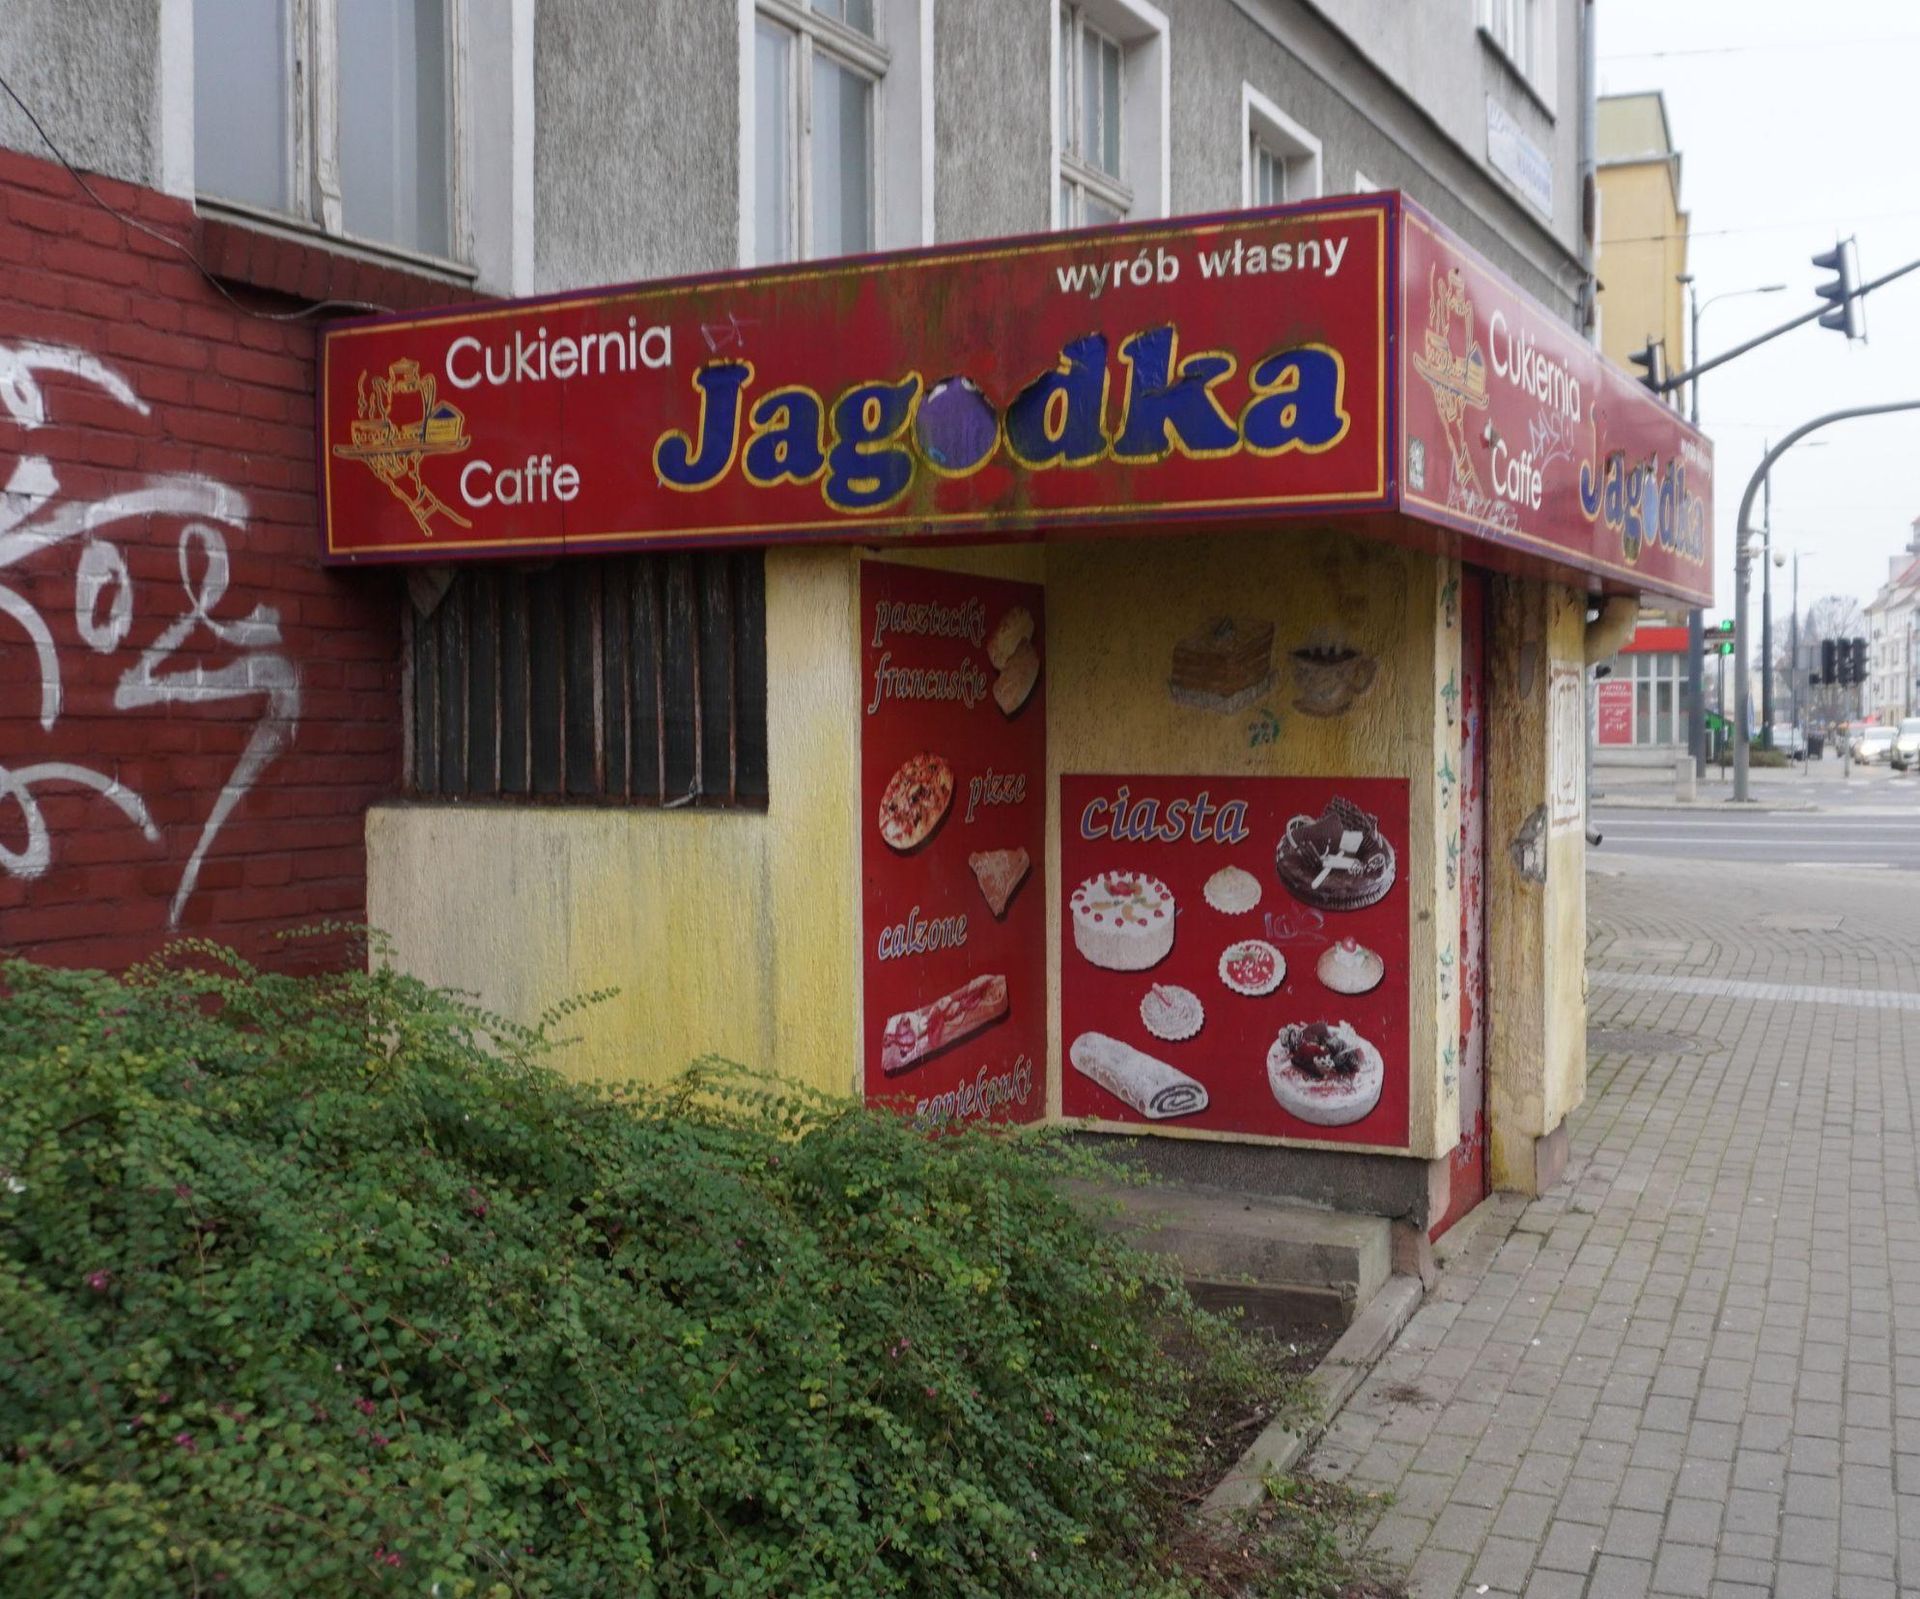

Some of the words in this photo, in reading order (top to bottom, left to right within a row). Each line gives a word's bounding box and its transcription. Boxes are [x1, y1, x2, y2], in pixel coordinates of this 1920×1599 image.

[1056, 247, 1180, 298] wyrób
[1198, 236, 1349, 279] własny
[445, 316, 673, 389] Cukiernia
[1489, 309, 1581, 422] Cukiernia
[459, 455, 581, 507] Caffe
[1491, 438, 1542, 511] Caffe
[871, 596, 986, 648] paszteciki
[867, 651, 987, 715] francuskie
[965, 768, 1027, 823] pizze
[1080, 785, 1250, 844] ciasta
[877, 904, 968, 961] calzone
